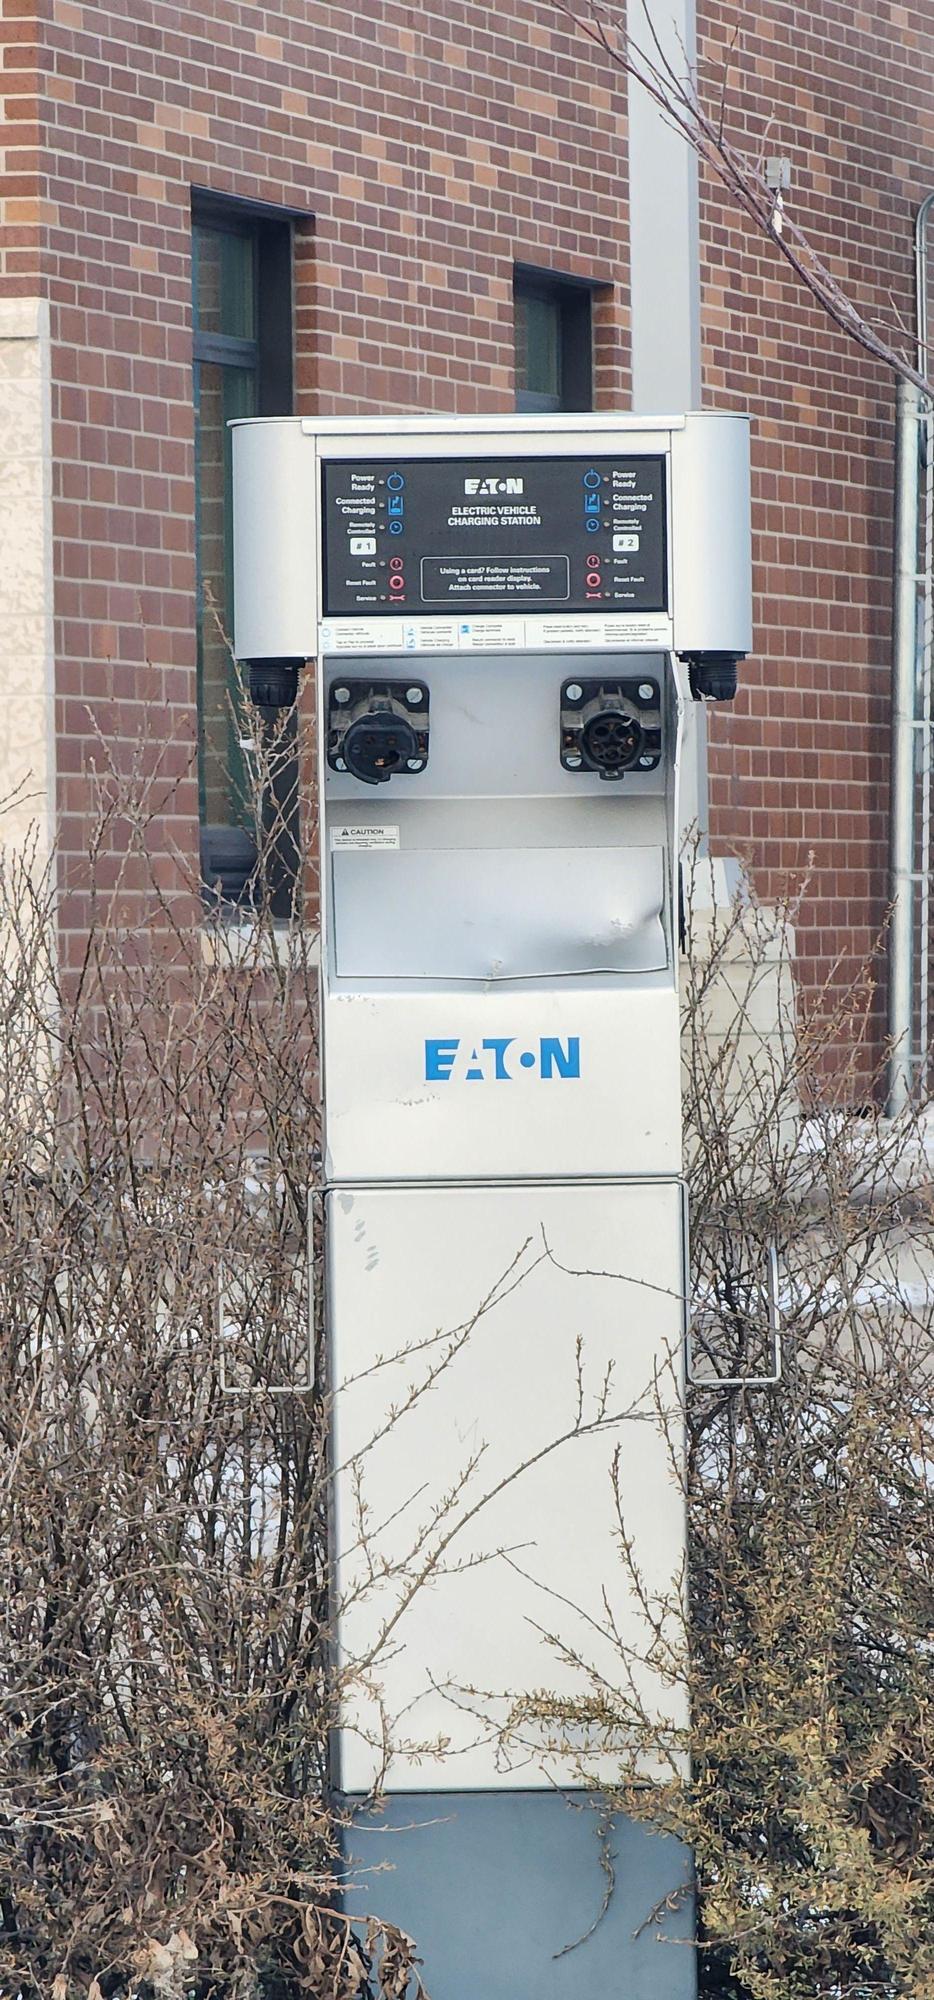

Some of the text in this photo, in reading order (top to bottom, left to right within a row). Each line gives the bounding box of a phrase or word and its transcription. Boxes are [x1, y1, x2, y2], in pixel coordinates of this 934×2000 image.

[351, 483, 375, 492] Ready
[464, 478, 523, 494] EATON
[612, 480, 636, 488] Ready
[335, 497, 376, 505] Connected
[612, 493, 653, 501] Connected
[341, 506, 376, 515] Charging
[452, 506, 537, 515] ELECTRIC VEHICLE
[612, 503, 647, 511] Charging
[448, 516, 541, 526] CHARGING STATION
[440, 567, 460, 575] Using
[424, 1037, 580, 1081] EATON
